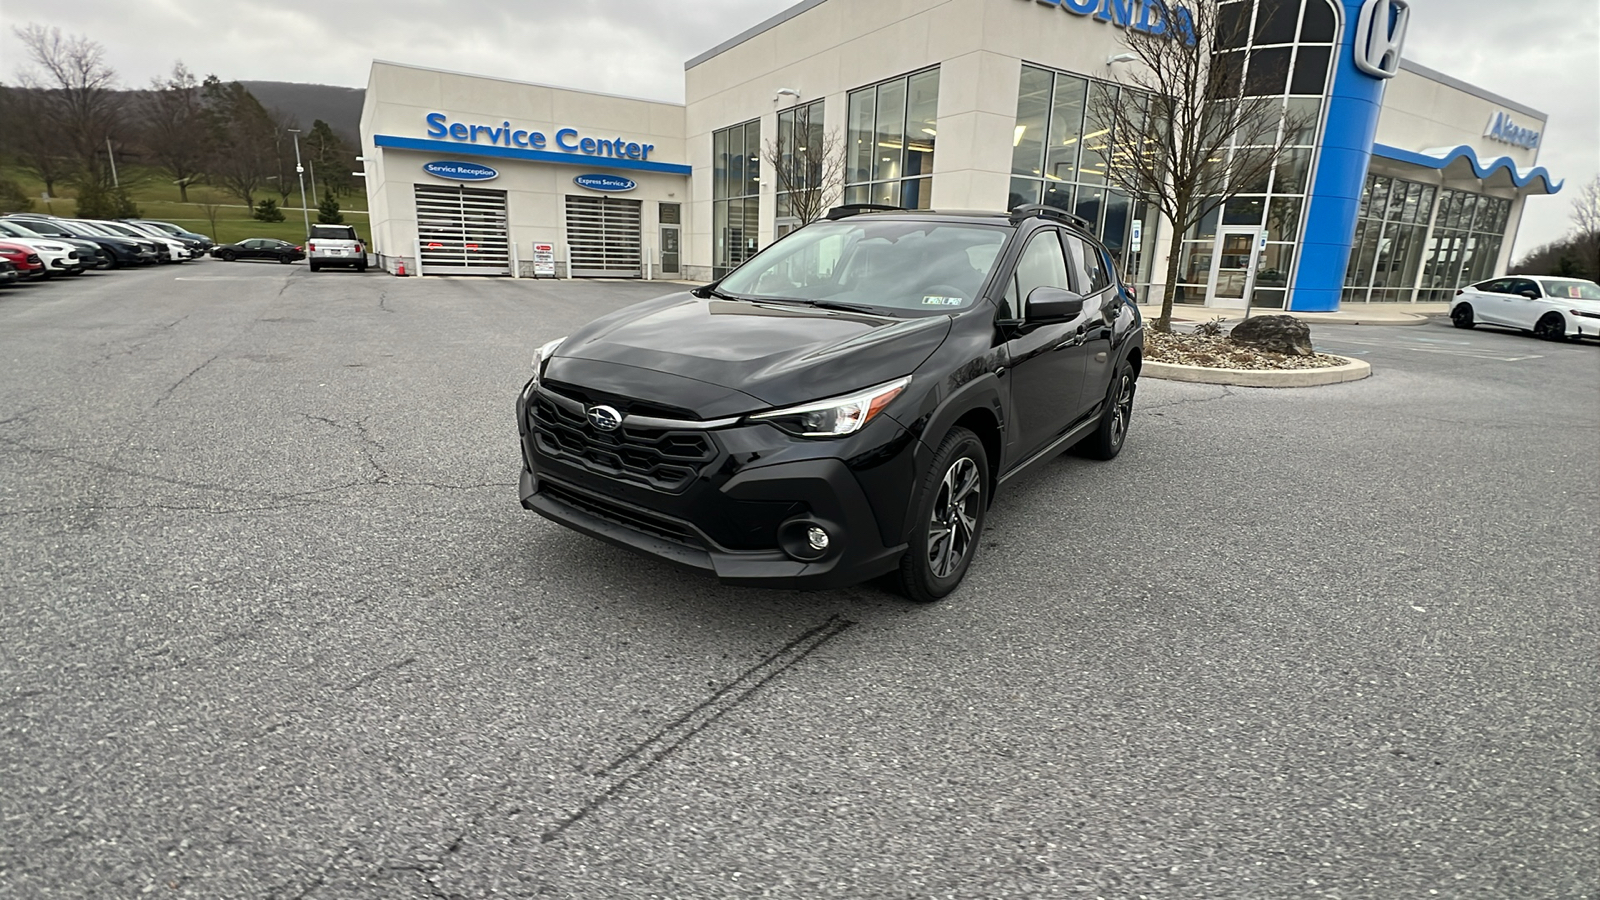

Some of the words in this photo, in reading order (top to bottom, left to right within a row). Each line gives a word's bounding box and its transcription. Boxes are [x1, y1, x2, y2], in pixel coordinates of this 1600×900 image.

[425, 112, 547, 149] Service
[555, 128, 655, 161] Center
[428, 164, 456, 173] Service
[457, 166, 494, 176] Reception
[577, 177, 602, 185] Express
[602, 179, 624, 187] Service
